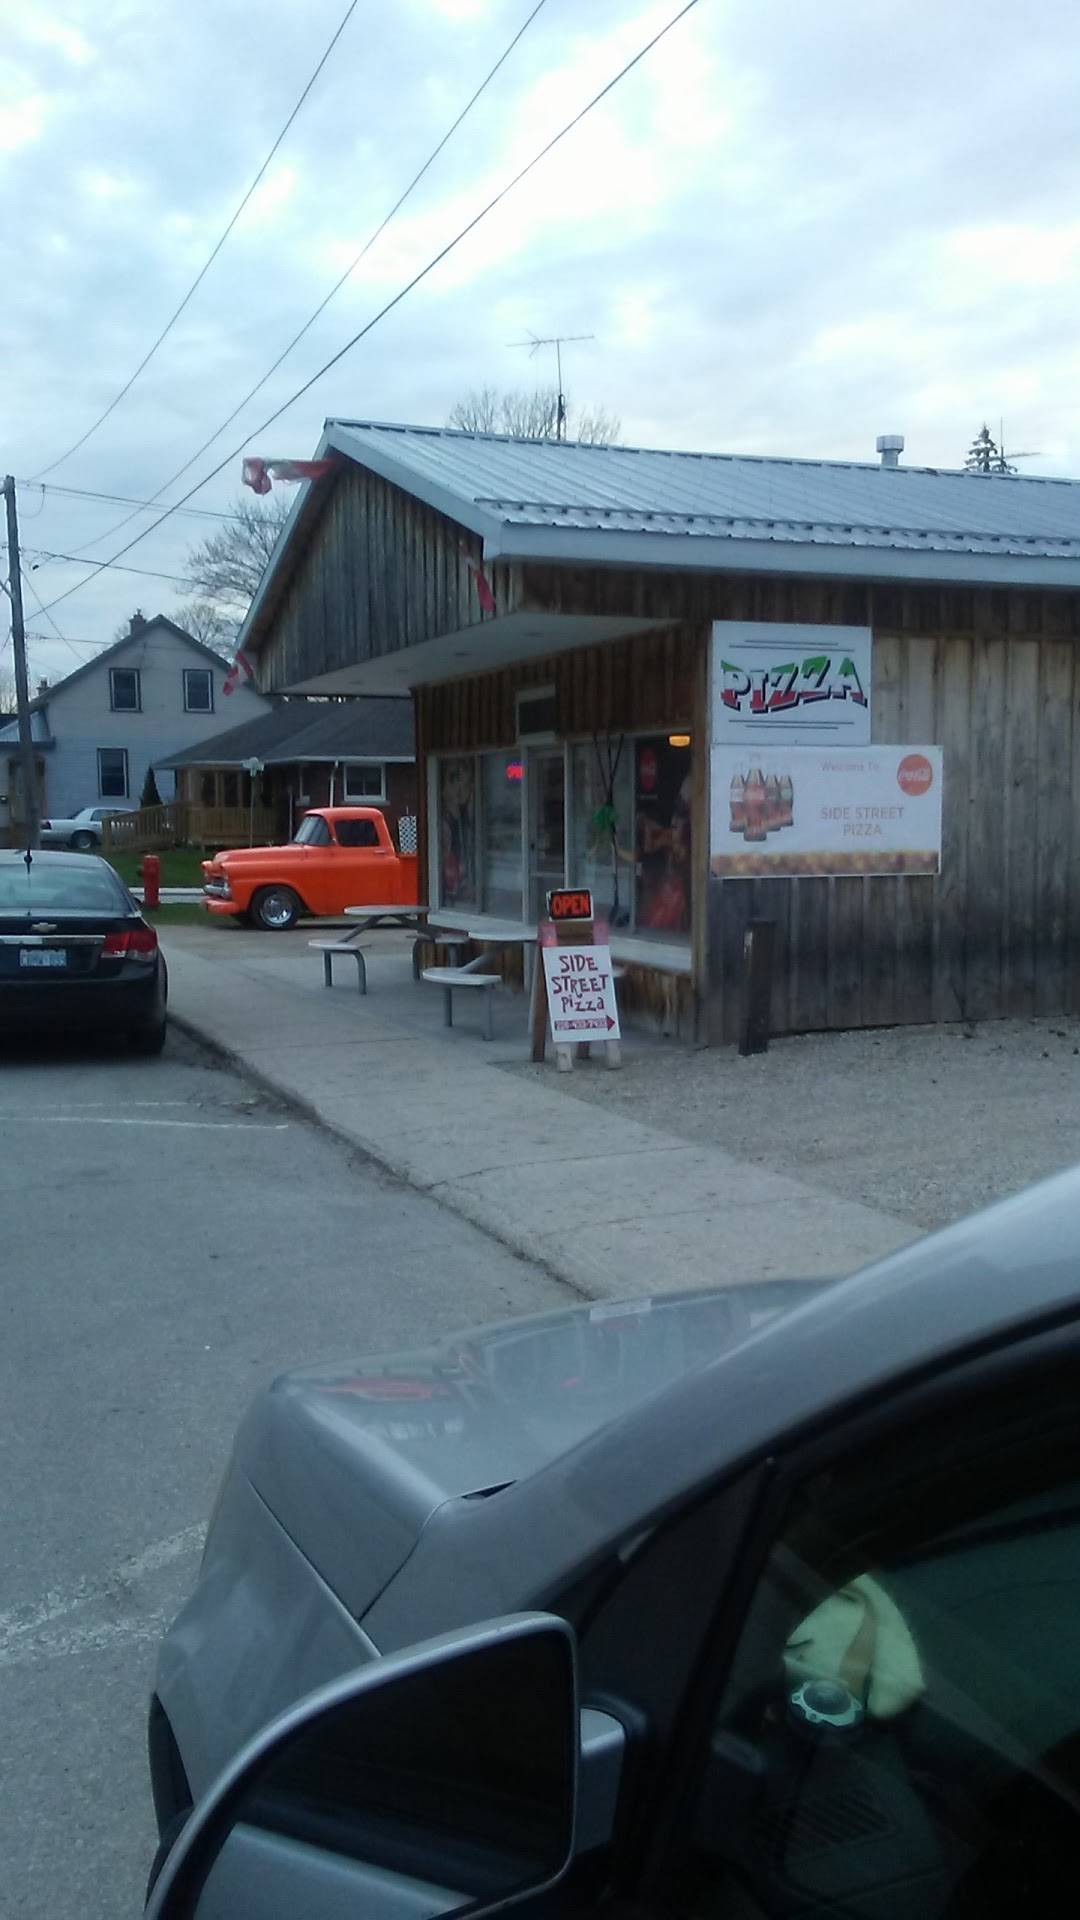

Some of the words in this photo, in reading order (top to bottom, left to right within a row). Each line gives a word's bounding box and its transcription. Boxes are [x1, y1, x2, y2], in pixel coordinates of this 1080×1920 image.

[720, 655, 868, 714] PIZZA
[821, 807, 850, 820] SIDE
[855, 806, 904, 819] STREET
[843, 823, 882, 836] PIZZA
[552, 894, 590, 916] OPEN
[559, 954, 598, 973] SIDE
[551, 974, 608, 998] STREET
